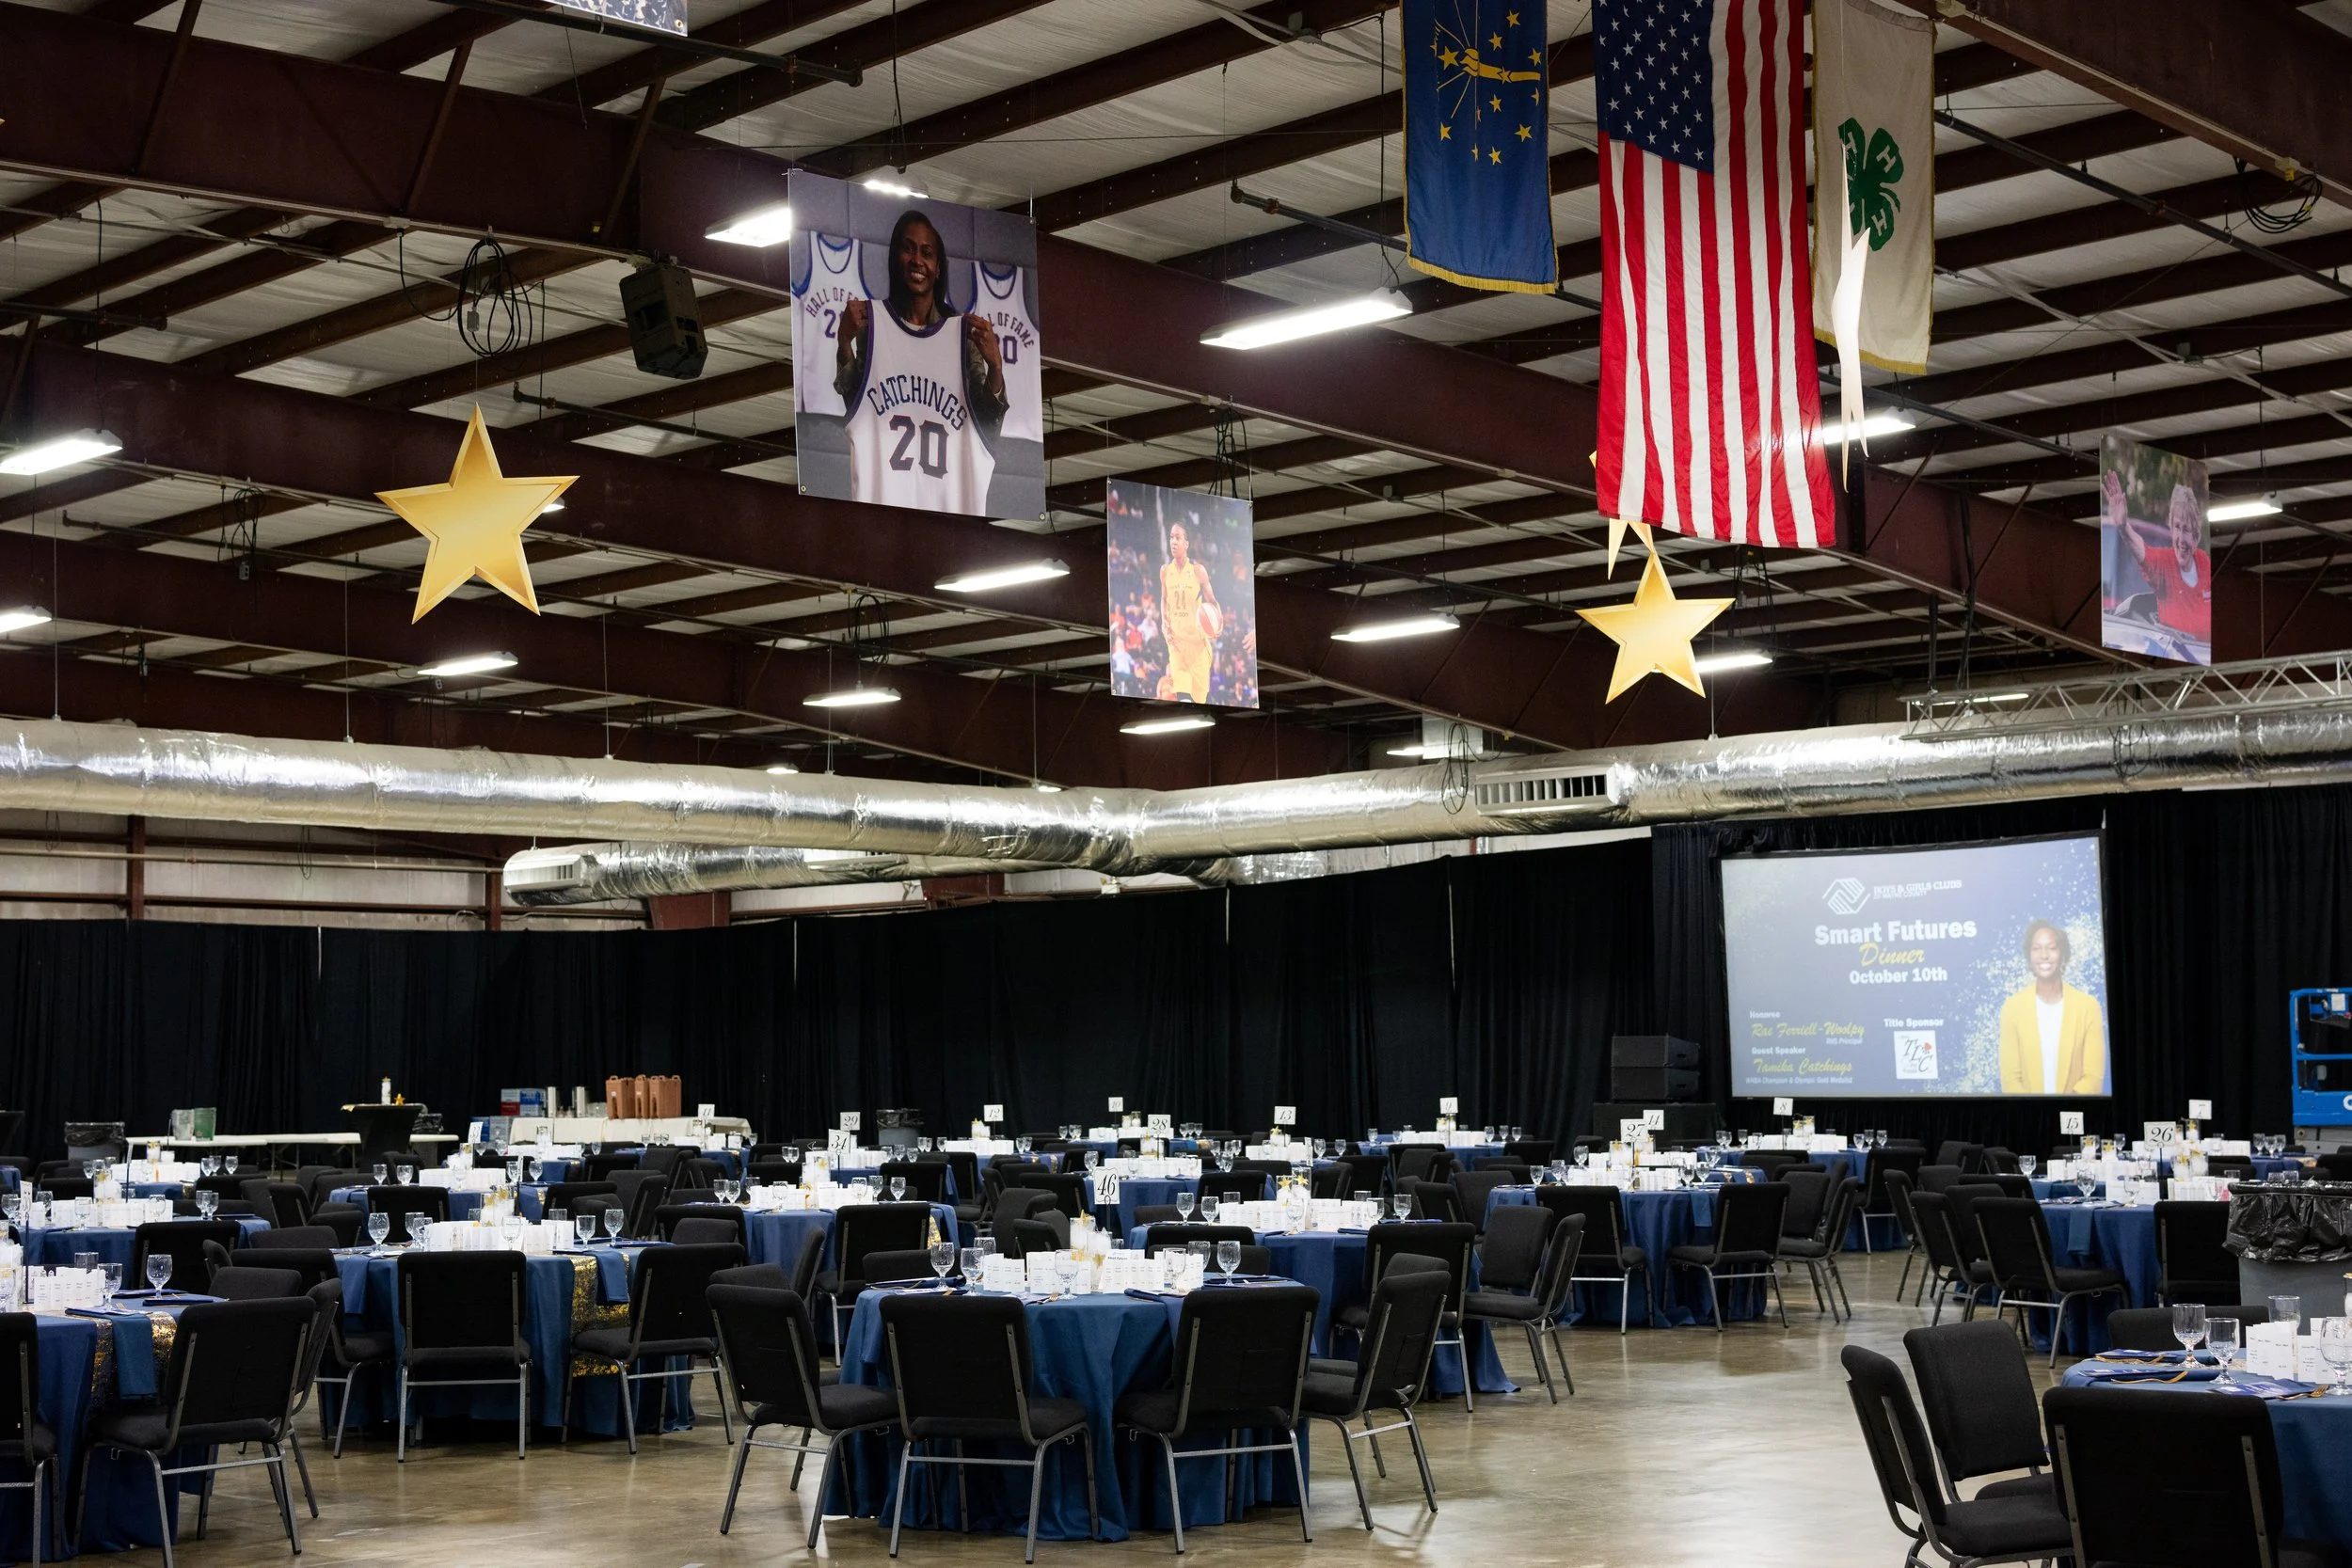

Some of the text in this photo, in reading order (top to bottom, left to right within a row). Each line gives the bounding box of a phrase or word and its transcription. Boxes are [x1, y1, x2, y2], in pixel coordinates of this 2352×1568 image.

[806, 288, 830, 318] HALL
[833, 287, 845, 302] OF
[824, 309, 844, 339] 2
[997, 311, 1010, 327] OF
[1010, 316, 1034, 348] FAME
[866, 374, 968, 431] CATCHINGS
[888, 414, 950, 480] 20
[1906, 881, 1931, 892] GIRLS
[1933, 879, 1963, 890] CLUBS
[1815, 920, 1978, 945] Smart Futures
[1858, 942, 1925, 967] Dinner
[1849, 967, 1947, 984] October 10th
[1750, 1010, 1781, 1019] Honoree
[1752, 1022, 1773, 1037] Rae
[1883, 1018, 1944, 1028] Title Sponsor
[1752, 1046, 1806, 1055] Guest Speaker
[1753, 1057, 1852, 1076] Tamika Catchings
[989, 1108, 1000, 1117] 12
[1279, 1110, 1293, 1120] 13
[843, 1115, 858, 1126] 29
[1152, 1117, 1168, 1130] 28
[2066, 1117, 2078, 1129] 15
[1625, 1123, 1645, 1137] 27
[2150, 1127, 2173, 1143] 26
[1097, 1173, 1117, 1196] 46
